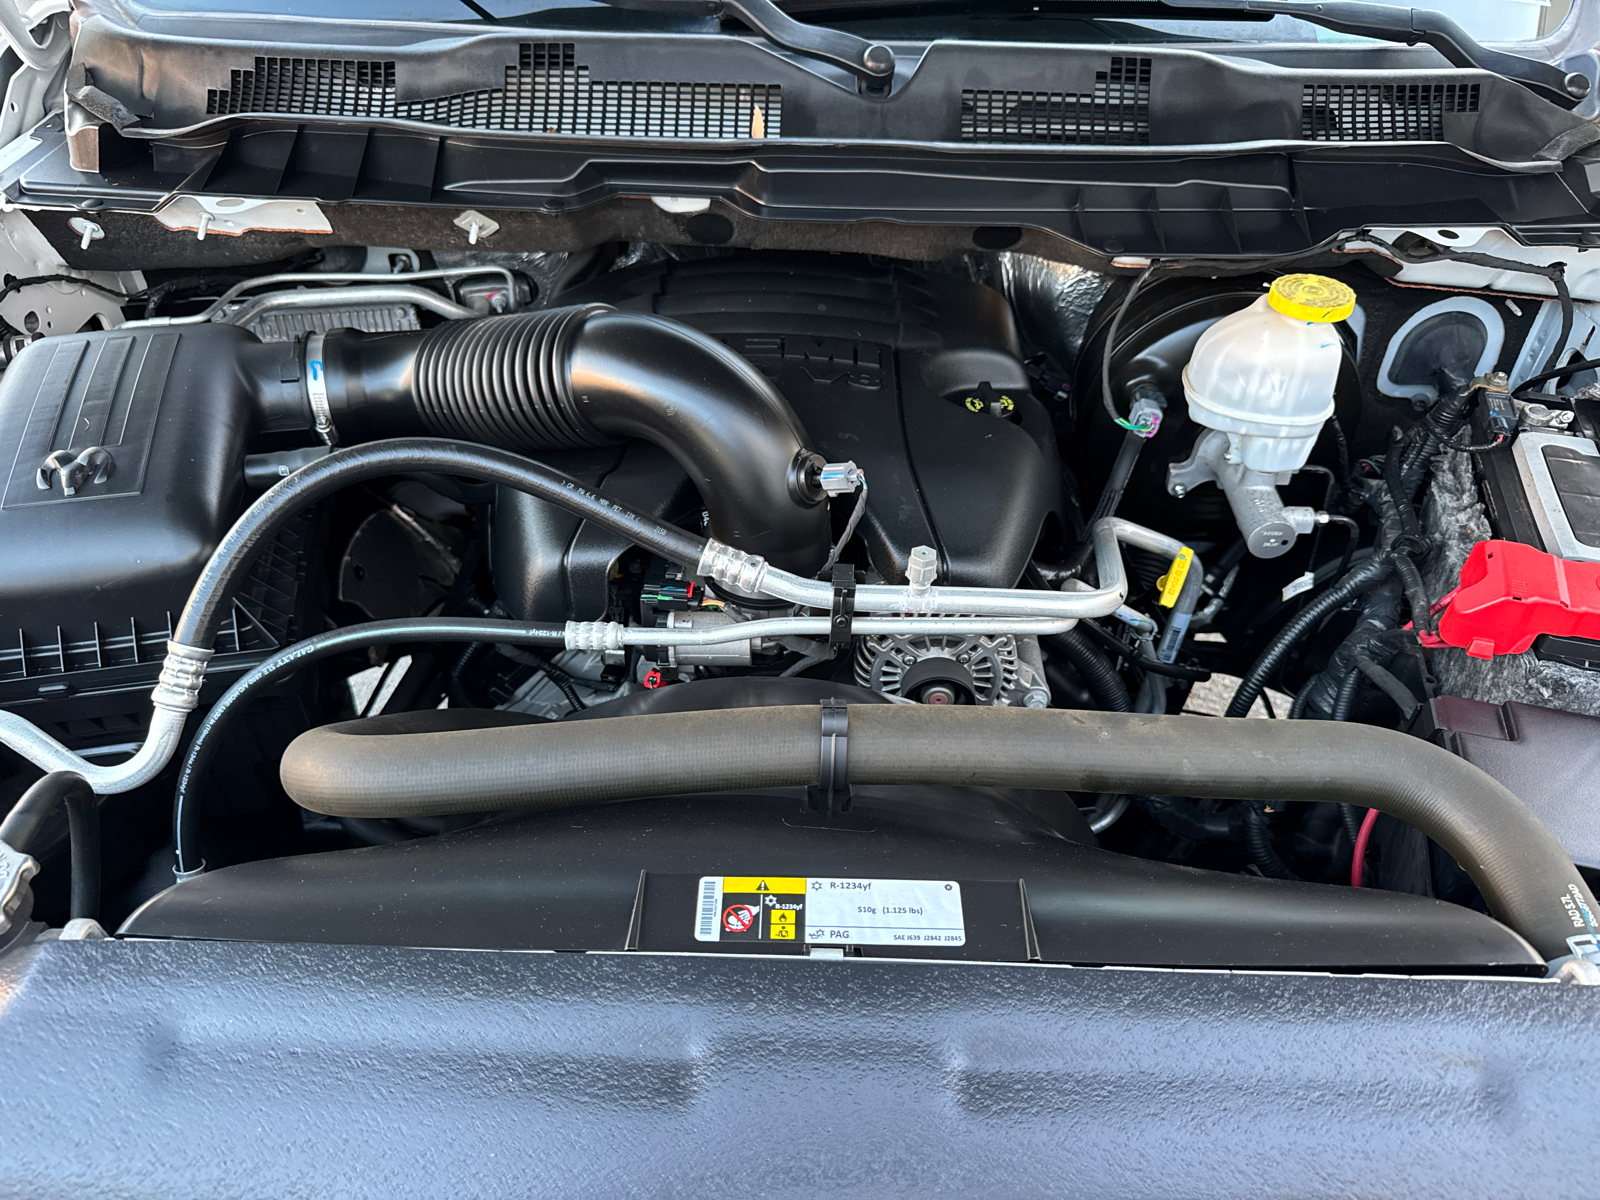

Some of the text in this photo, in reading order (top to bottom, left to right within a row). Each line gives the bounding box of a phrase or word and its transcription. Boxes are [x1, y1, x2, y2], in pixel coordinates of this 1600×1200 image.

[277, 645, 314, 668] GALAXY
[261, 663, 276, 676] SLE
[225, 691, 240, 707] HOSE
[830, 881, 872, 892] R-1234yf
[857, 906, 923, 916] 510g (1.125 lbs)
[1568, 909, 1585, 927] RAD
[830, 930, 850, 939] PAG
